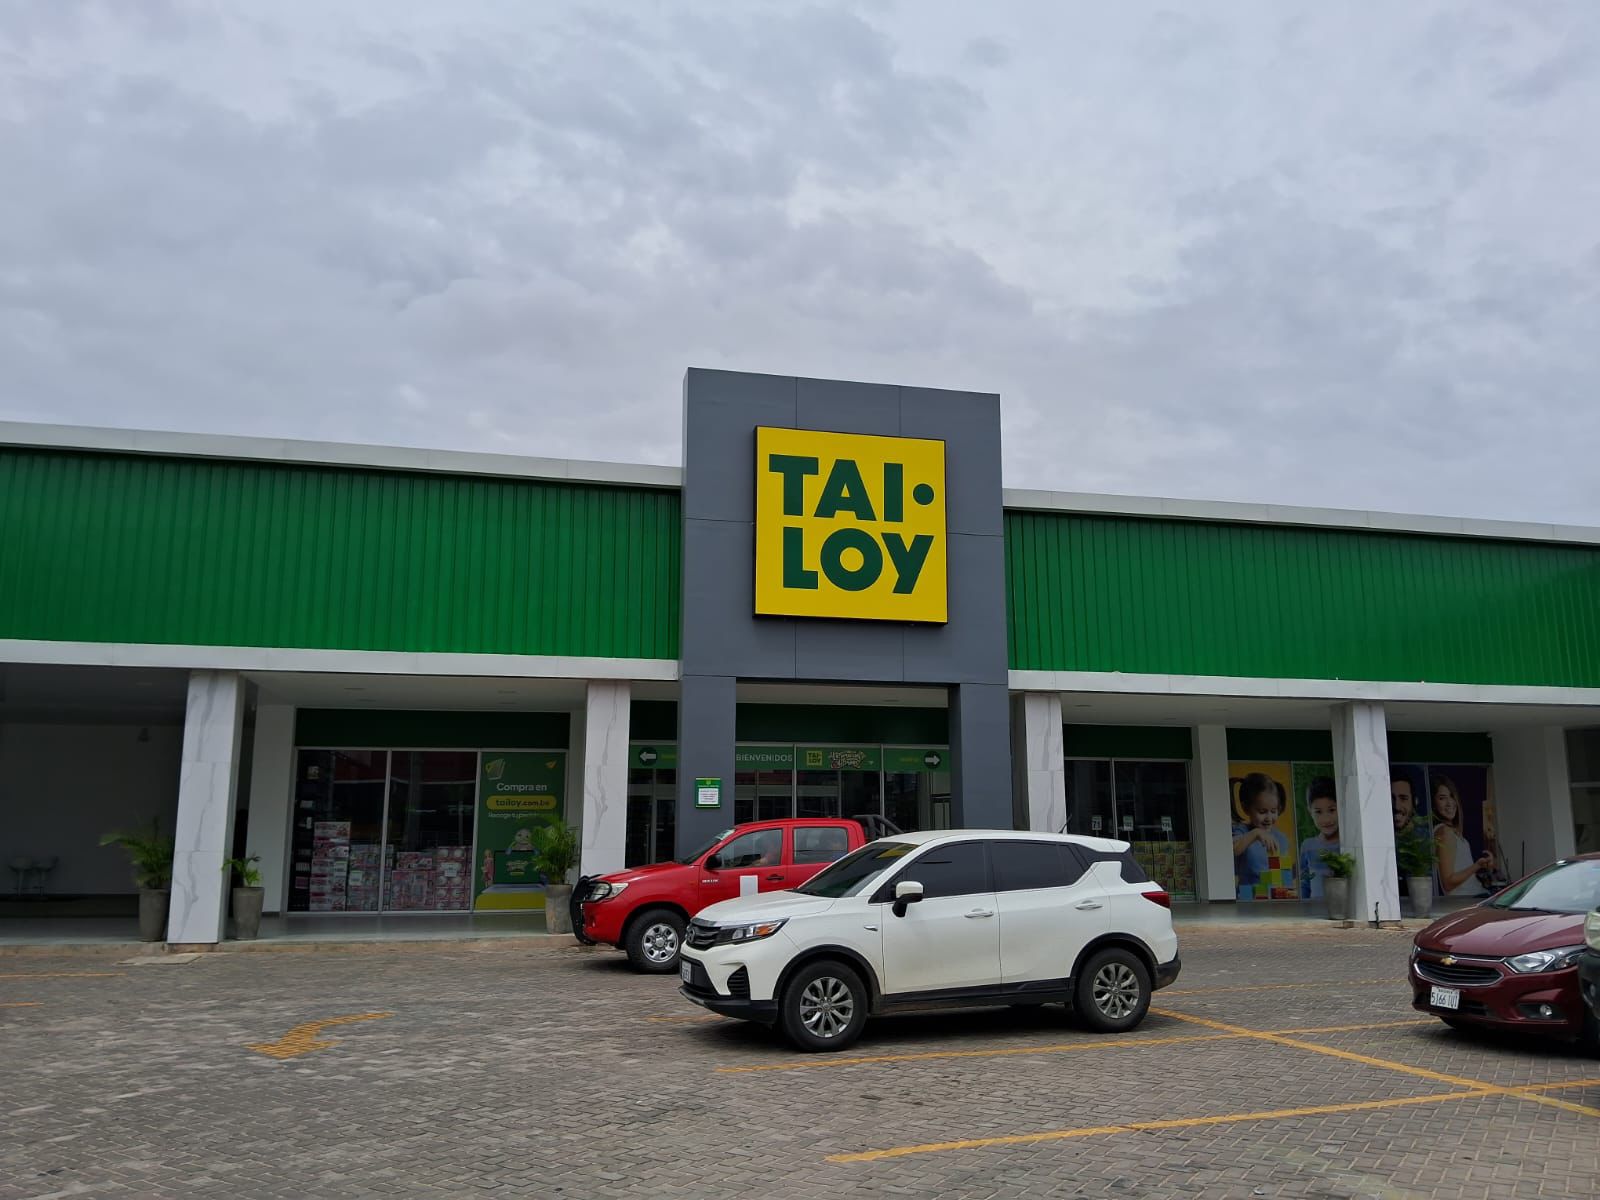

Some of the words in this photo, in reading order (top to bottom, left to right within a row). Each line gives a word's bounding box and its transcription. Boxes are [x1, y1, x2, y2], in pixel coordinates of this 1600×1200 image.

[783, 526, 935, 595] LOY
[736, 753, 793, 762] BIENVENIDOS
[497, 783, 533, 792] Compra
[535, 784, 548, 792] en
